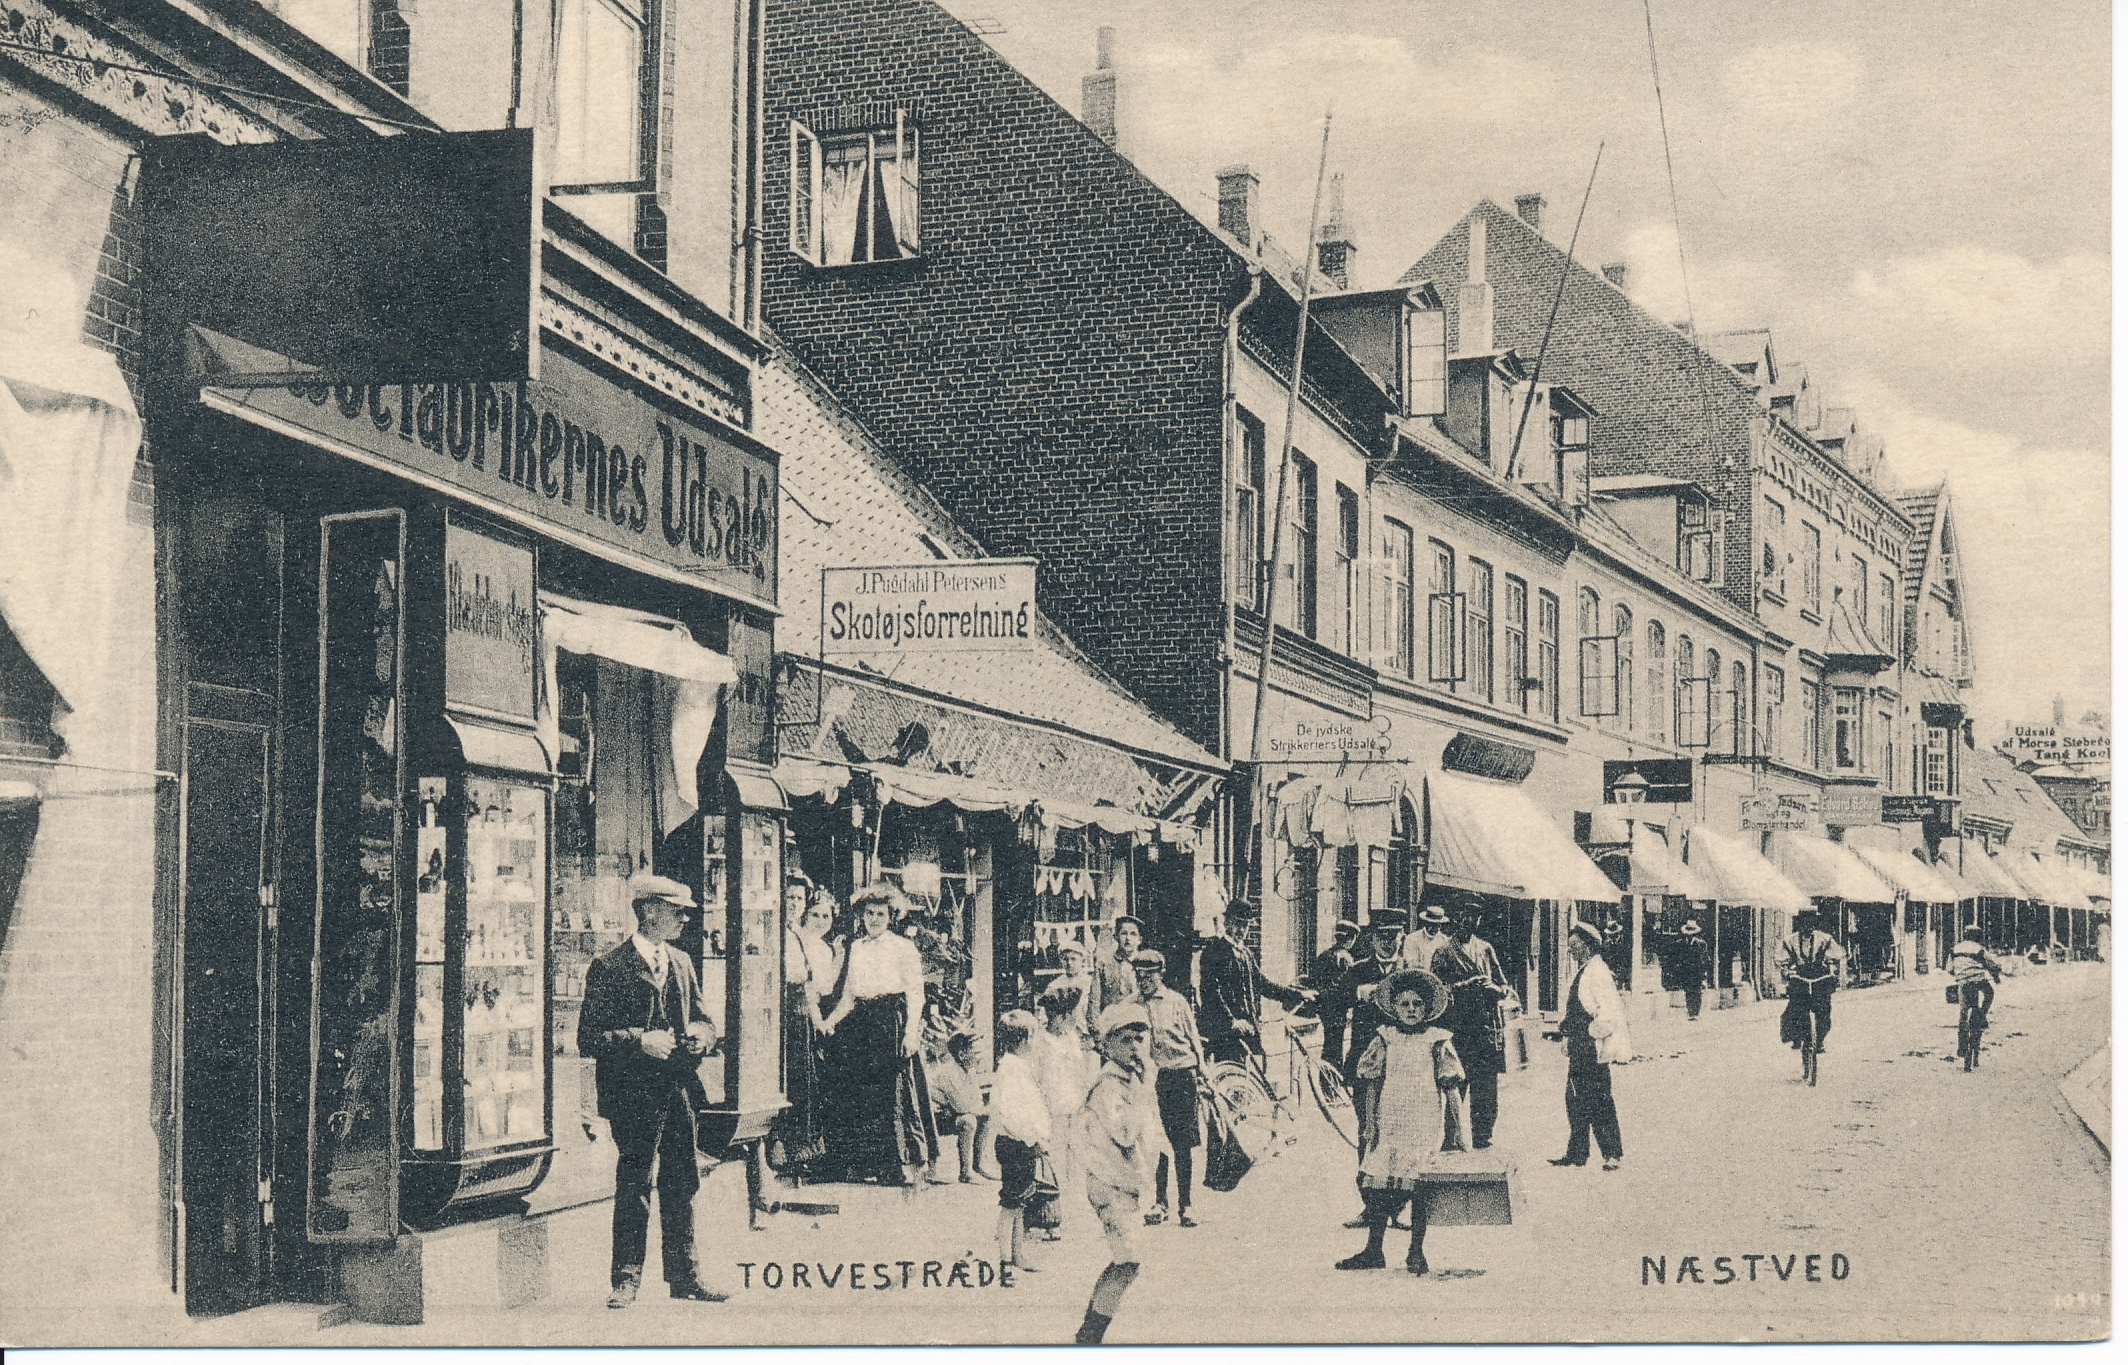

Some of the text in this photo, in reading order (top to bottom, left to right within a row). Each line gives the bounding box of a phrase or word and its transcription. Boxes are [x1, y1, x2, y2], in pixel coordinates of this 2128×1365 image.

[656, 420, 768, 584] Udsalg
[830, 600, 1029, 646] Skotøjsforretning
[1296, 723, 1353, 737] De jydske
[2015, 726, 2055, 736] Udsalg
[1338, 738, 1377, 750] Udsalg
